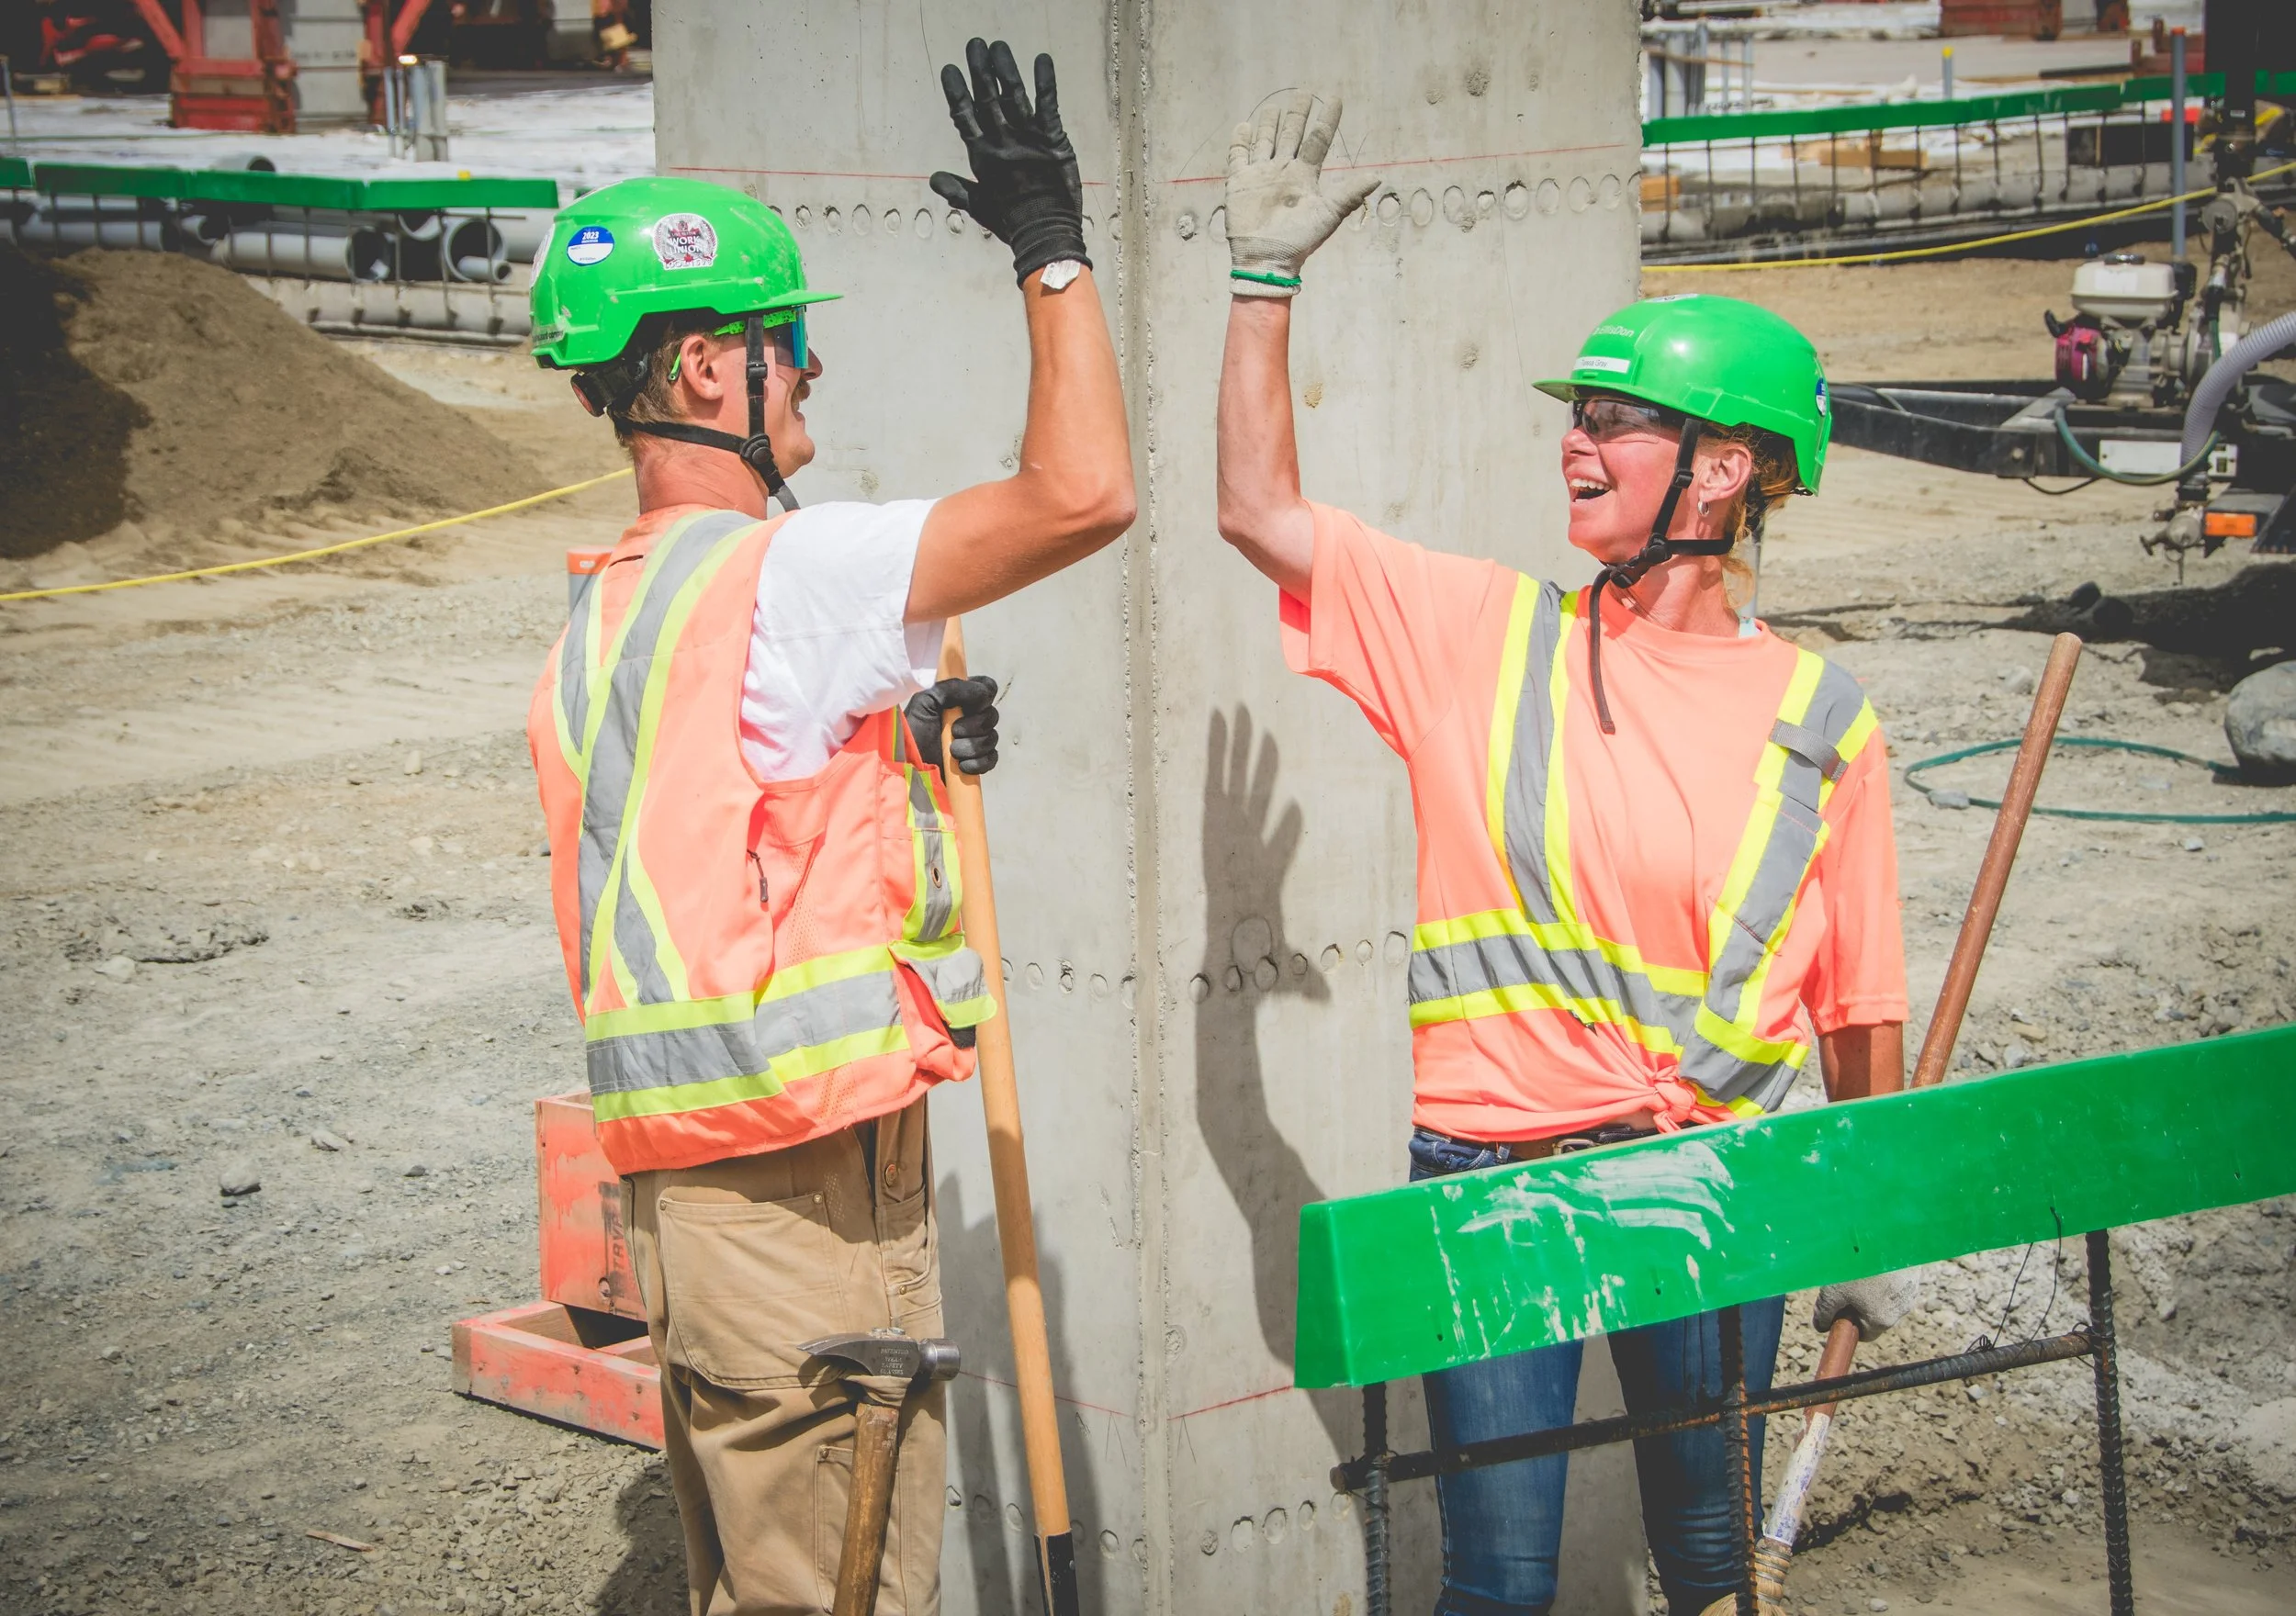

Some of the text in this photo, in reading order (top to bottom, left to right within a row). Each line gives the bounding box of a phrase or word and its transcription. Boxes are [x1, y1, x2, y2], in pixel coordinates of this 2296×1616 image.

[582, 231, 599, 240] 2023
[670, 235, 701, 245] WORK
[670, 244, 703, 253] UNION
